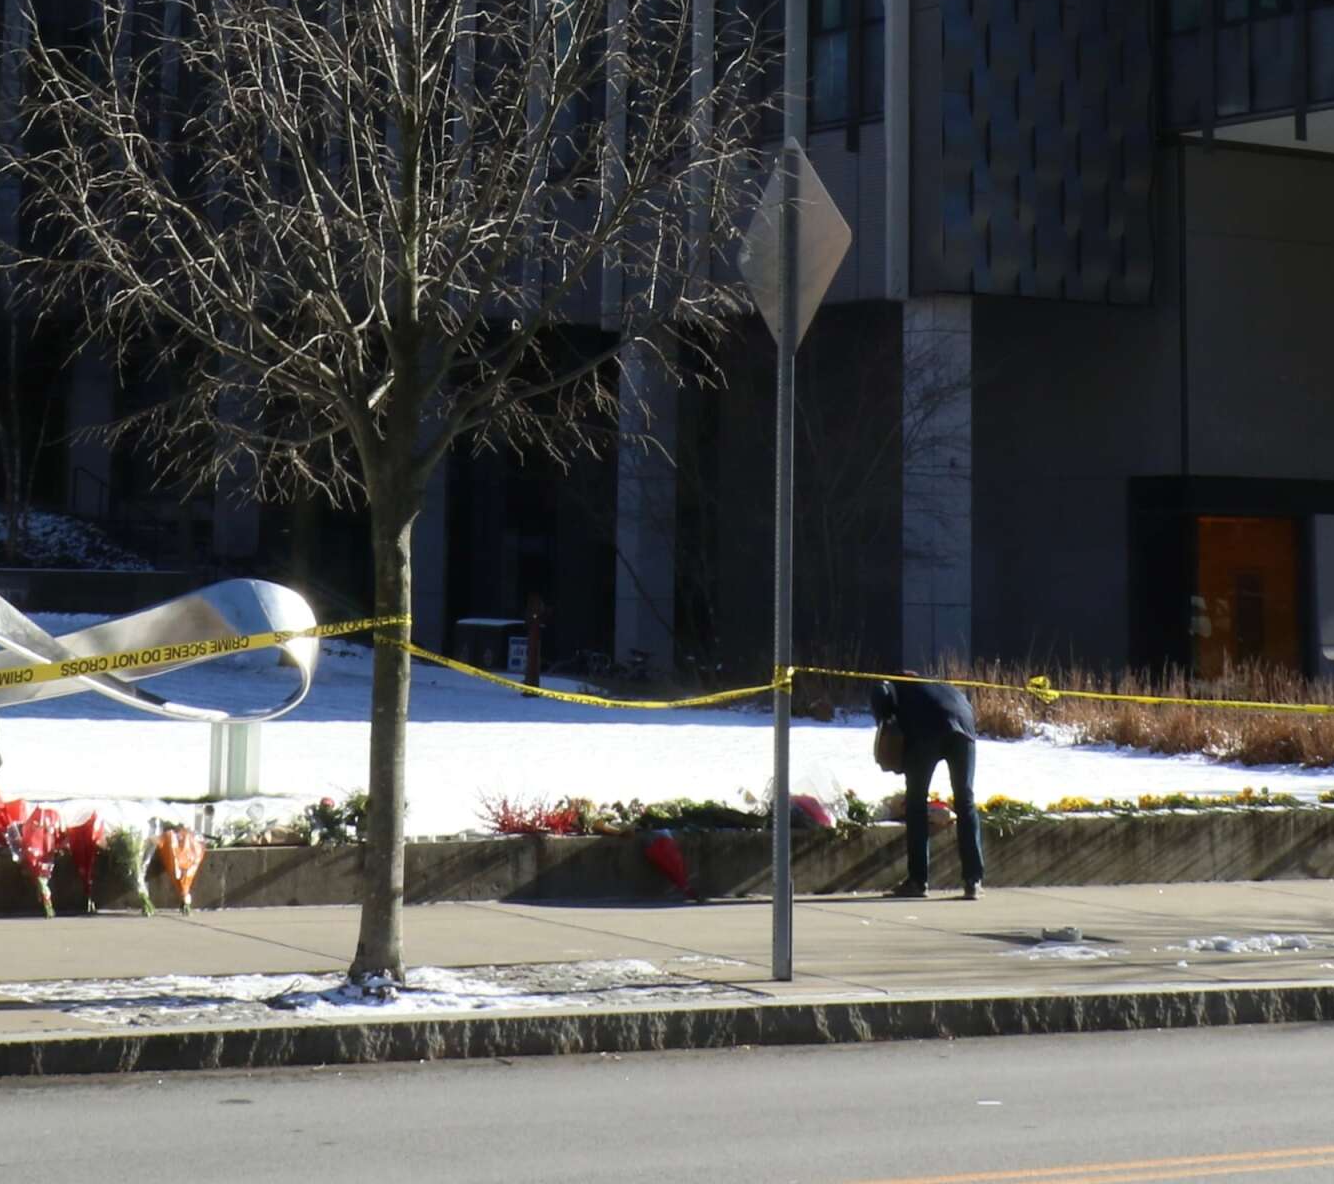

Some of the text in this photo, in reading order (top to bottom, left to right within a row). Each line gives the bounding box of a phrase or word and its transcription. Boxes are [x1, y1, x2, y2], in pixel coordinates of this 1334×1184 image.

[60, 635, 250, 677] CRIME SCENE DO NOT CROSS
